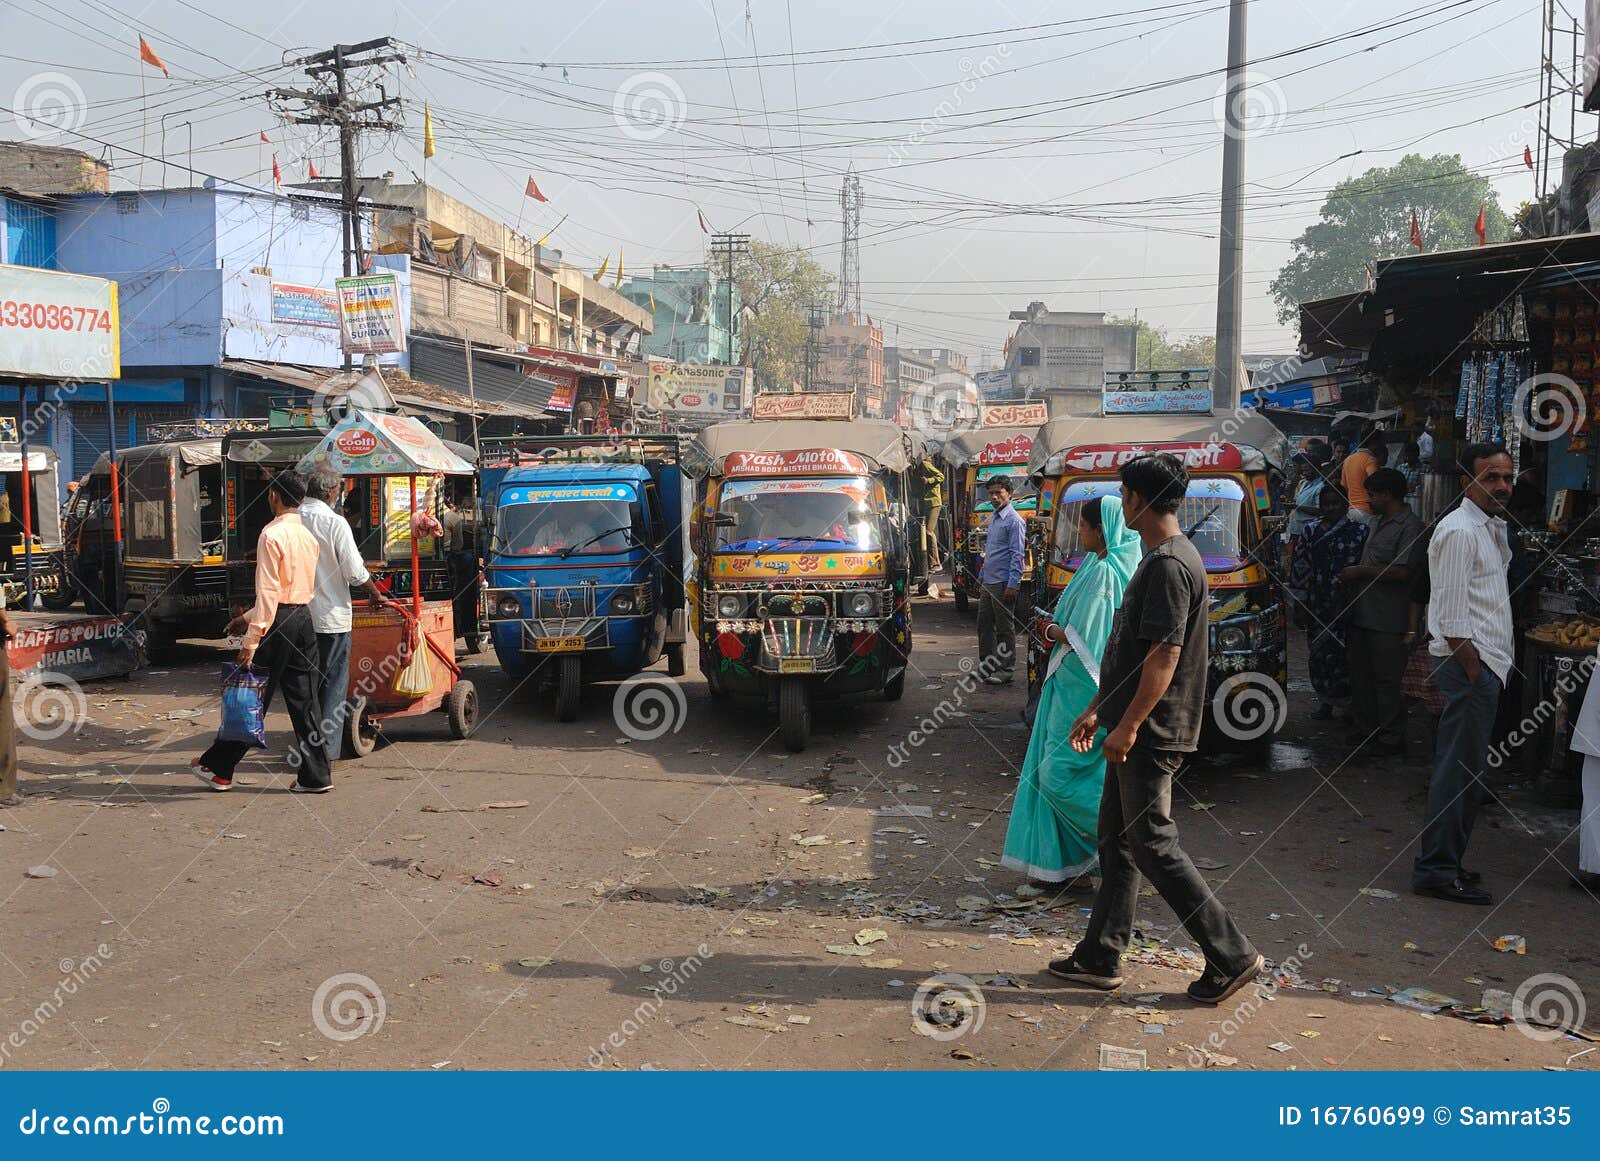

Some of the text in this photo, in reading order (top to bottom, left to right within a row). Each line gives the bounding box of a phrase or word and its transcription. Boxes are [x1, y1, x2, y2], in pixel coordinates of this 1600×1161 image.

[0, 300, 112, 334] 33036774
[359, 321, 381, 330] EVERY
[351, 328, 391, 340] SUNDAY
[670, 365, 725, 378] Panasonic
[338, 437, 375, 447] Coolfi
[738, 453, 785, 466] Yash
[731, 463, 760, 473] ARSHAD
[761, 465, 782, 473] BODY
[783, 464, 811, 473] MISTRI
[812, 463, 837, 471] BHAGA
[732, 558, 752, 572] शुभ
[844, 556, 865, 570] लाभ
[73, 622, 125, 642] POLICE
[36, 647, 93, 669] JHARIA
